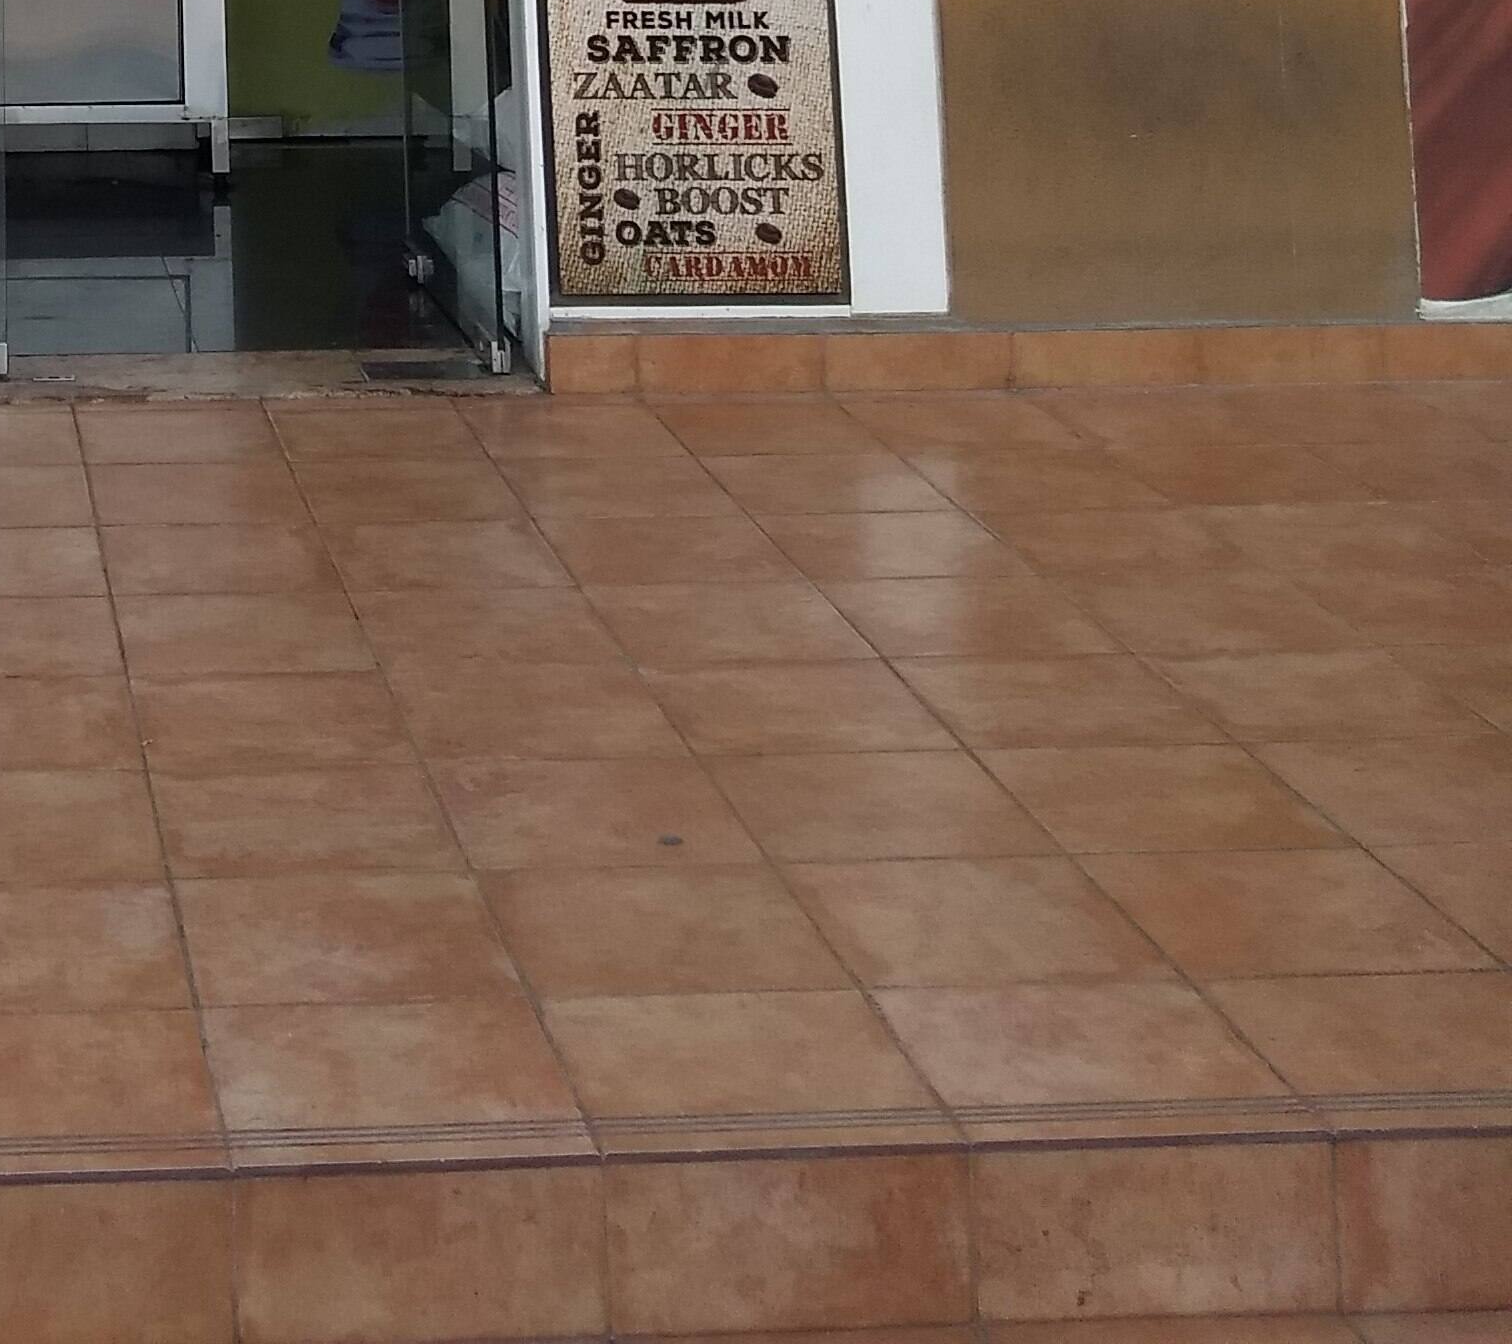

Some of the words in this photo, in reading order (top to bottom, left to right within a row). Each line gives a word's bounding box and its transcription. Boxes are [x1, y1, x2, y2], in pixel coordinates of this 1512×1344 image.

[605, 11, 693, 30] FRESH
[704, 11, 770, 30] MILK
[587, 34, 791, 65] SAFFRON
[573, 72, 738, 100] ZAATAR
[651, 112, 790, 141] GINGER
[614, 152, 825, 181] HORLICKS
[575, 110, 606, 265] GINGER
[654, 187, 790, 215] BOOST
[615, 220, 717, 246] OATS
[645, 255, 814, 279] CARDAMOM
